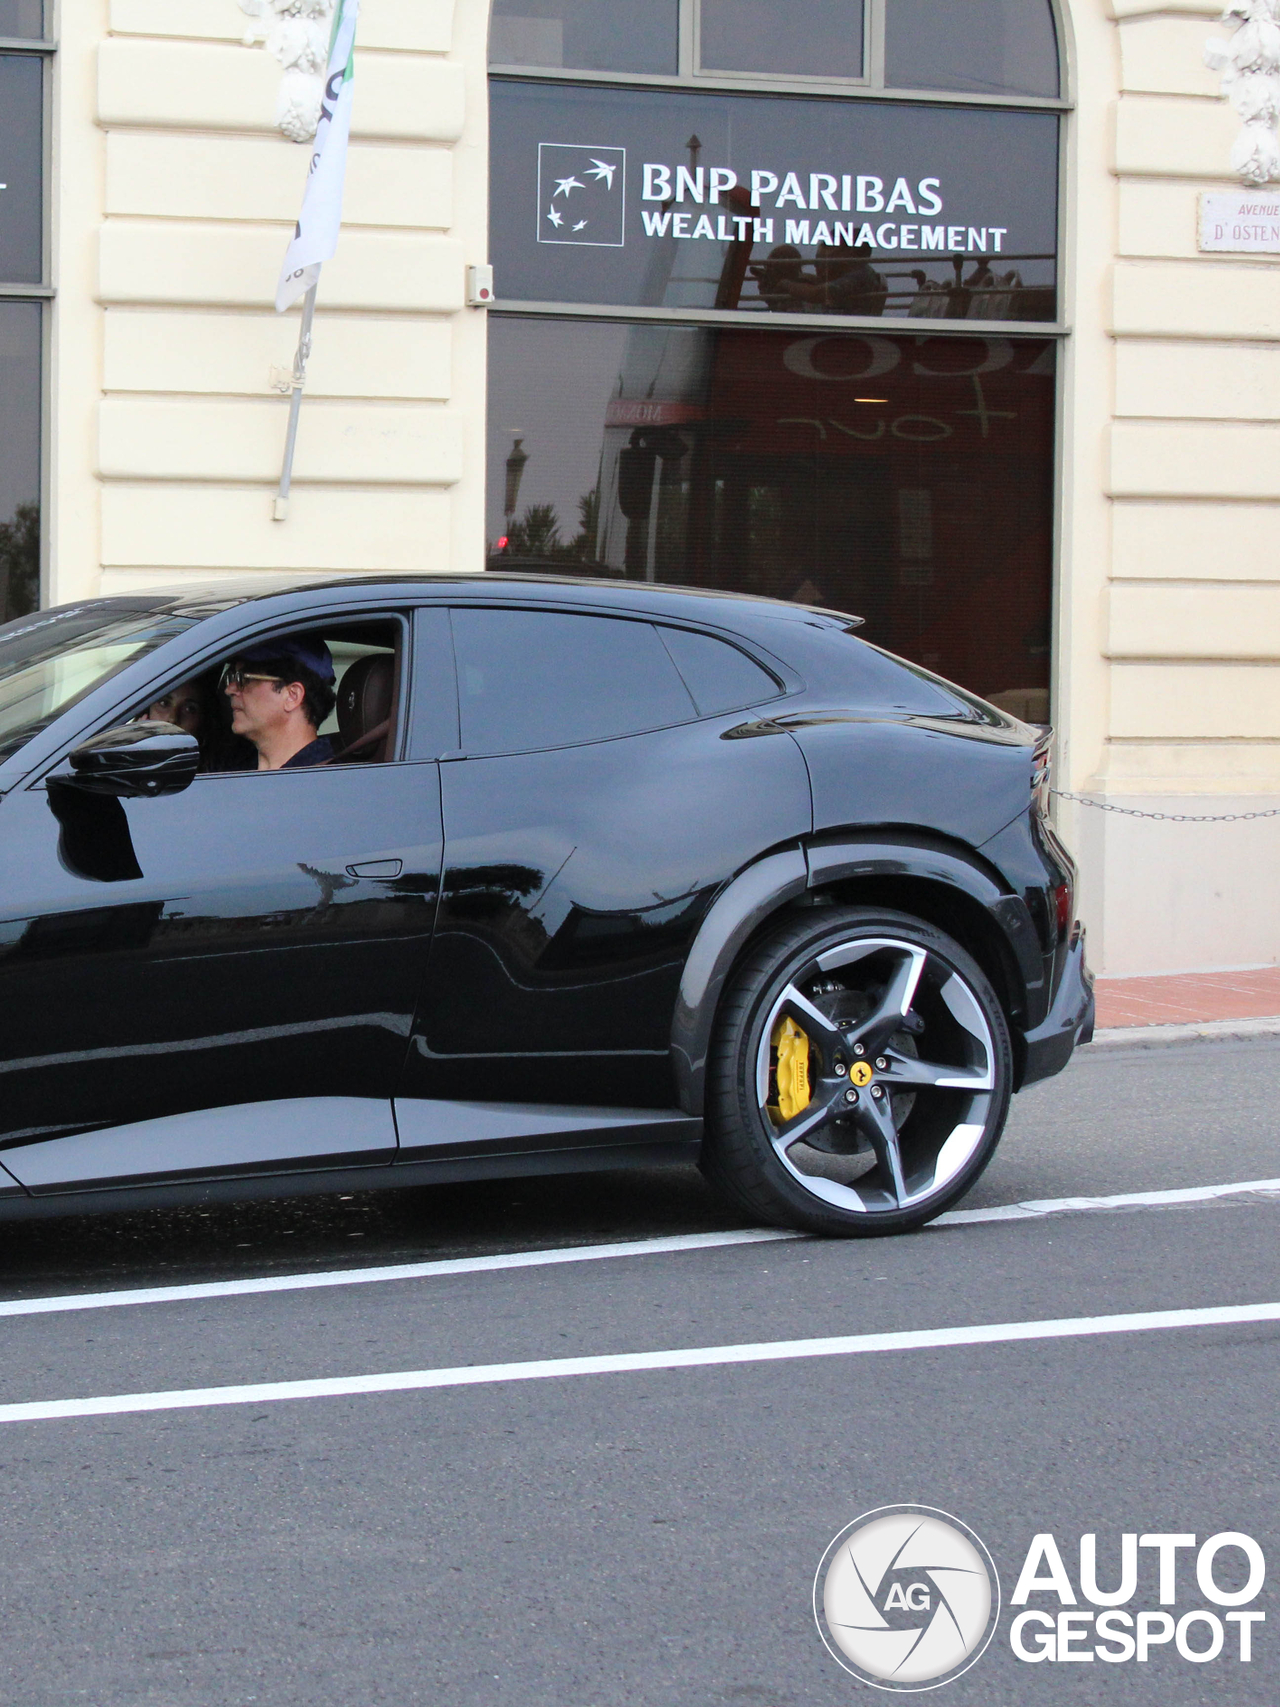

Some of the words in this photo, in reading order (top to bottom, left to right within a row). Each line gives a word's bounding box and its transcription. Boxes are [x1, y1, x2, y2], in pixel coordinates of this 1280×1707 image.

[642, 163, 738, 205] BNP
[750, 169, 943, 216] PARIBAS
[1238, 204, 1280, 216] AVENUE
[640, 210, 774, 243] WEALTH
[785, 218, 1008, 252] MANAGEMENT
